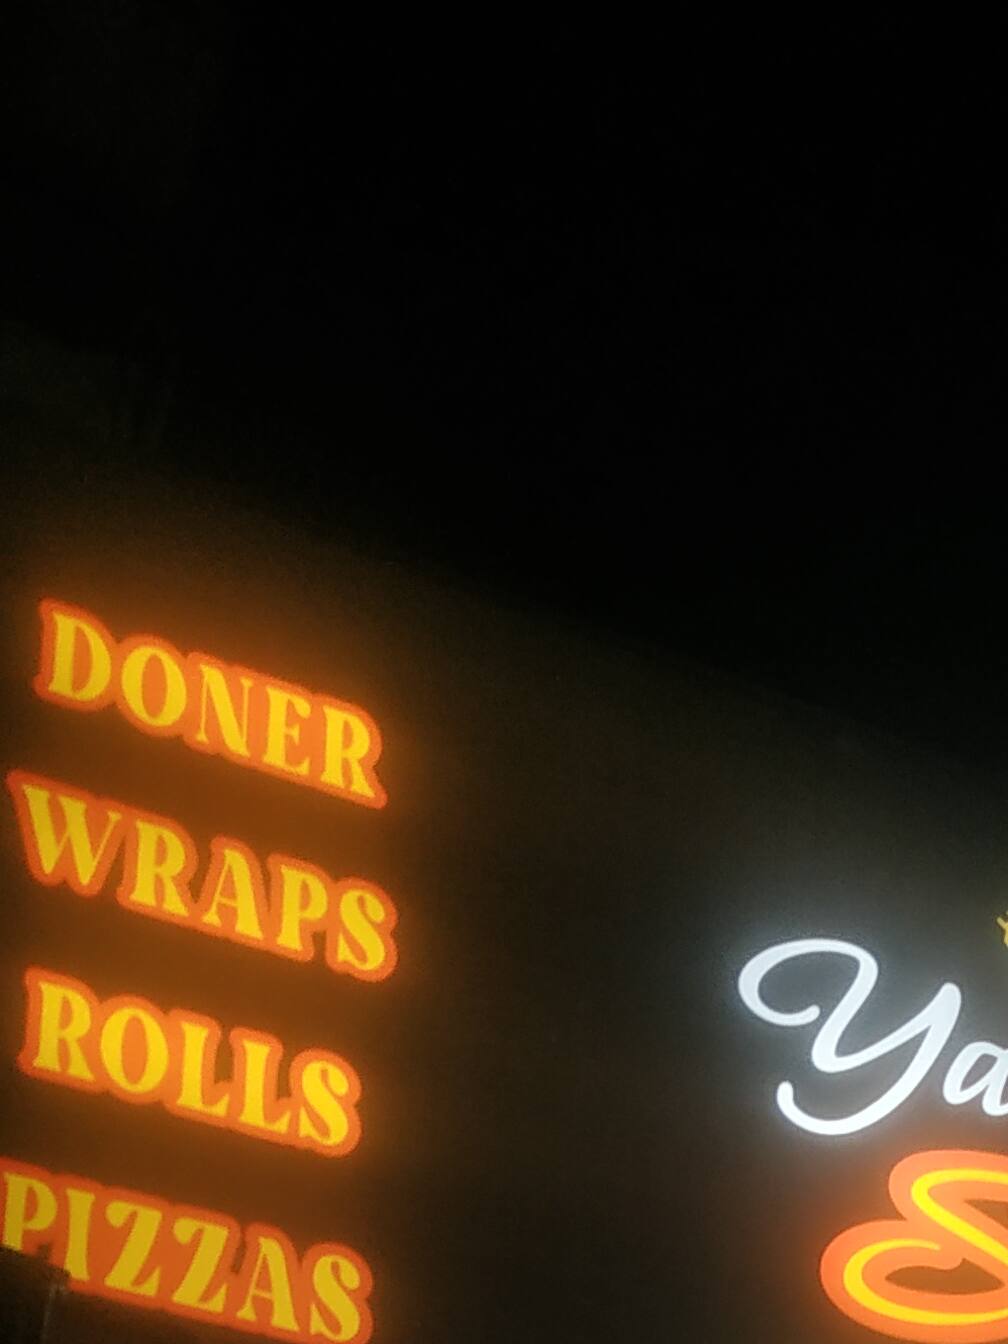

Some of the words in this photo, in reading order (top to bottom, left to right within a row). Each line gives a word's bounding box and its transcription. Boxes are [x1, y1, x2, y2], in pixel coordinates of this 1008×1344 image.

[46, 606, 382, 802] DONER
[14, 777, 393, 977] WRAPS
[26, 974, 356, 1152] ROLLS
